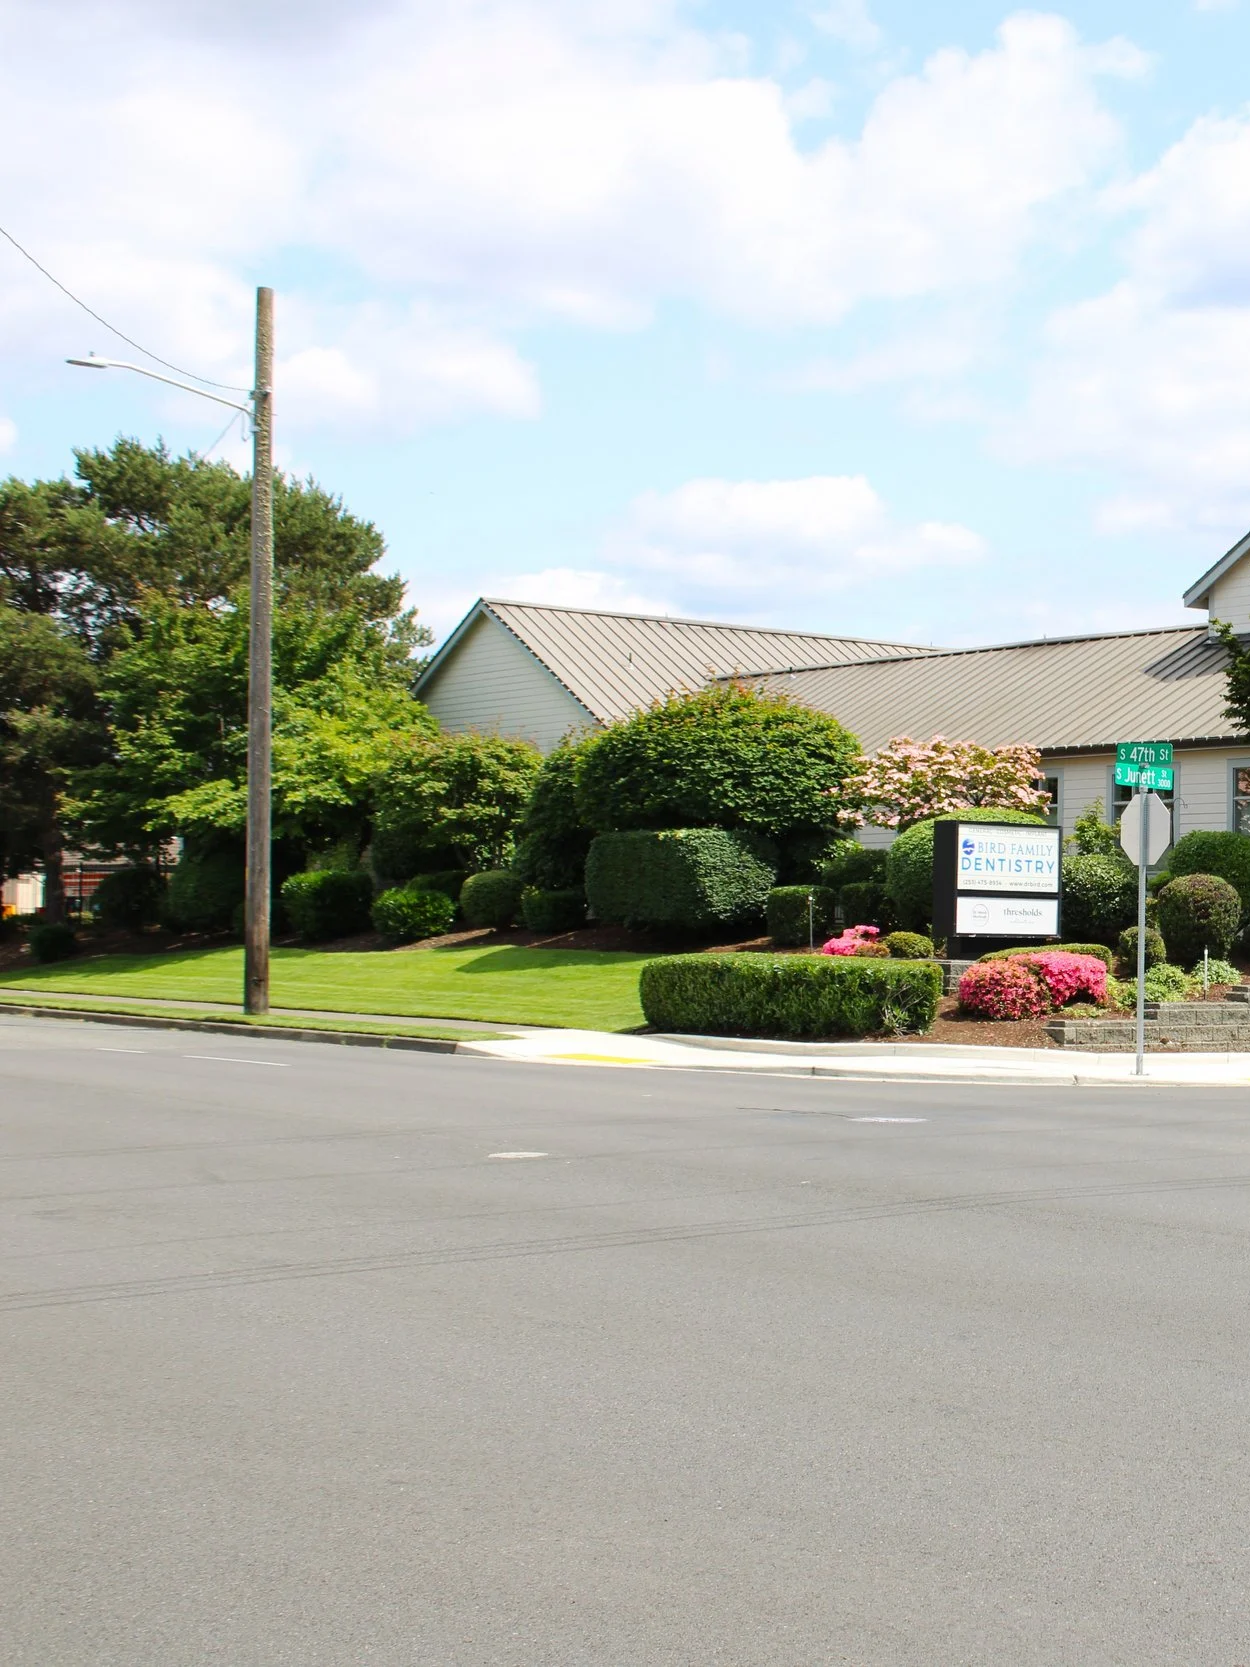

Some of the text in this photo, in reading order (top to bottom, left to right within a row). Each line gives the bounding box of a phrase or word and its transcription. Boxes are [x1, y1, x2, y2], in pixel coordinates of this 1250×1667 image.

[1120, 747, 1168, 762] S 47th St
[1116, 767, 1167, 785] S Junett St
[978, 842, 1053, 856] BIRD FAMILY
[961, 857, 1055, 873] DENTISTRY
